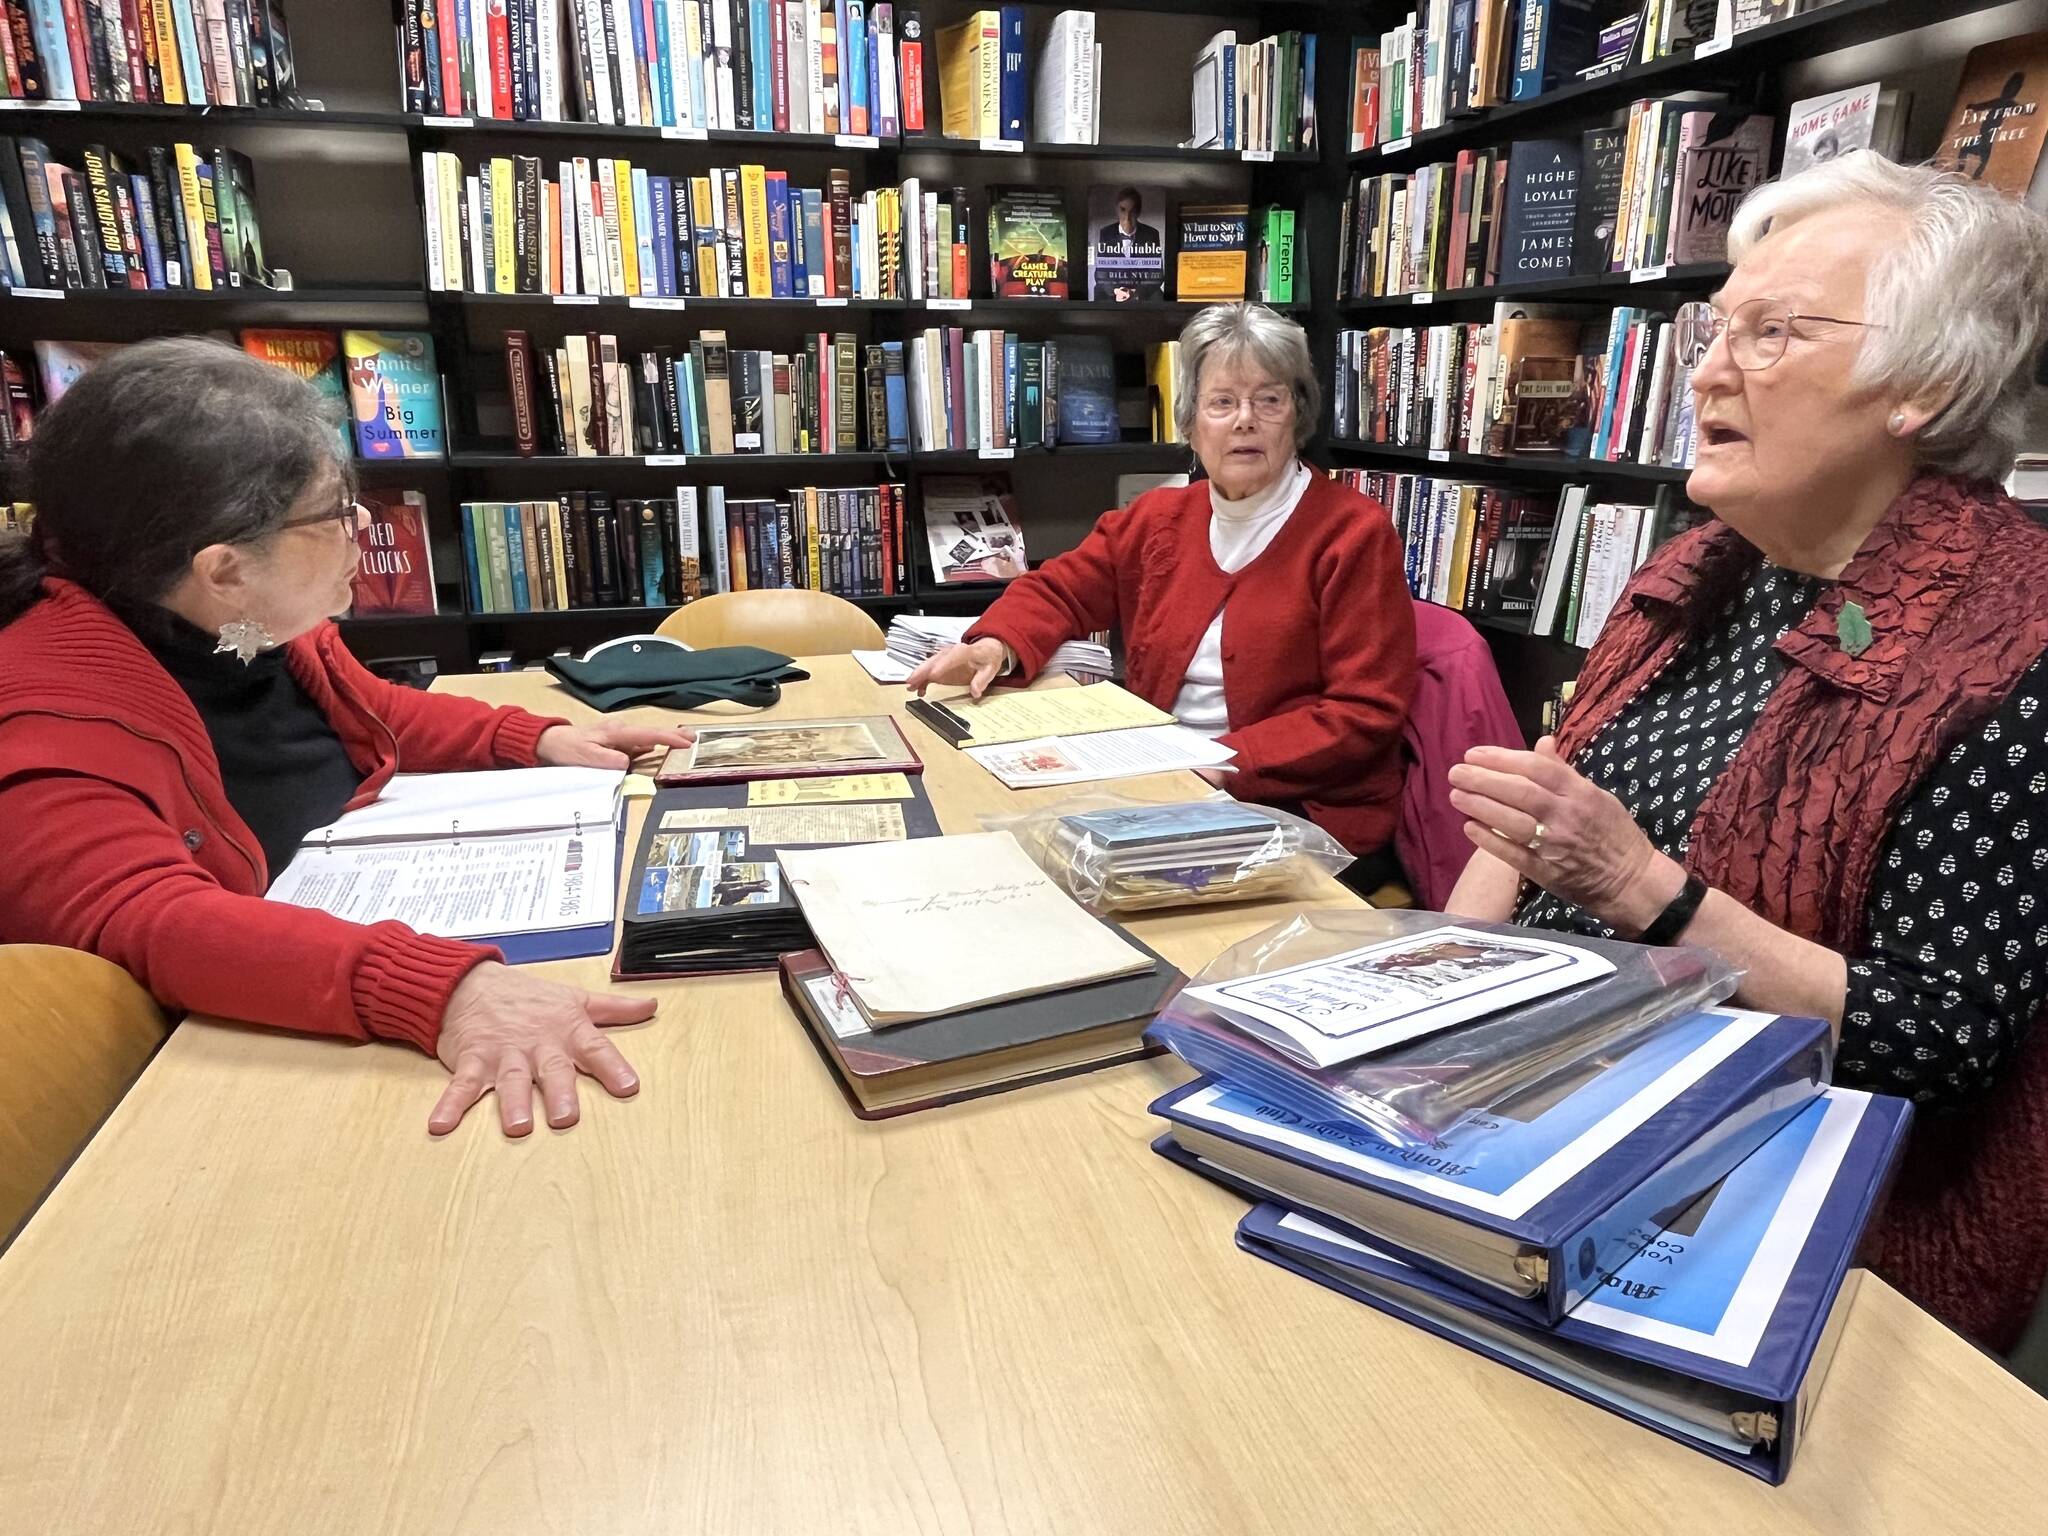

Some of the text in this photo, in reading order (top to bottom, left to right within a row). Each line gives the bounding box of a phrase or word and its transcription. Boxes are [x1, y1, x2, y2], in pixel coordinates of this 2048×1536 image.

[511, 9, 520, 49] CLINTON
[588, 0, 606, 75] GANDHI
[496, 35, 507, 93] MATRIARCH
[543, 26, 553, 101] HARRY SPARE
[813, 40, 824, 94] Educated
[983, 41, 991, 118] WORD MENU
[1520, 55, 1532, 72] LES
[1791, 93, 1872, 140] HOME GAME
[1994, 101, 2038, 121] FROM
[1553, 154, 1561, 163] A
[1697, 150, 1753, 189] LIKE
[1526, 170, 1576, 184] HIGHE
[84, 151, 121, 252] JOHN SANDFORD
[655, 190, 664, 211] DIANA
[1524, 189, 1579, 202] LOYALT
[116, 185, 136, 250] JOHN SANDFORD
[517, 180, 526, 255] Known Unknown
[526, 162, 537, 277] DONALD RUMSFELD
[582, 202, 594, 256] Educated
[602, 186, 619, 241] POLITICIAN
[657, 212, 667, 237] PALMER
[675, 189, 689, 241] DIANA PALMER
[750, 184, 762, 245] DAVID BALDACCI
[1183, 221, 1245, 233] What to Say &
[1097, 242, 1162, 254] Undeniable
[1184, 232, 1244, 244] How to Say It
[730, 239, 743, 276] THE INN
[1013, 270, 1057, 278] CREATURES
[1021, 262, 1048, 270] GAMES
[1281, 234, 1292, 282] French
[1025, 278, 1045, 286] PLAY
[266, 340, 321, 357] ROBERT
[1468, 329, 1476, 364] ONCE
[353, 357, 432, 372] Jennifer
[361, 377, 430, 395] Weiner
[665, 357, 679, 433] WILLIAM FAULKNER
[1464, 367, 1475, 401] UPON
[1521, 385, 1571, 393] THE CIVIL WAR
[385, 406, 414, 425] Big
[1460, 414, 1469, 439] CAR
[364, 425, 438, 441] Summer
[681, 490, 693, 551] MATTHEW REILLY
[1449, 489, 1460, 525] BAILOUT
[369, 522, 395, 547] RED
[780, 515, 792, 563] REVENANT
[1595, 519, 1605, 553] WINNERS
[362, 549, 412, 576] CLOCKS
[1467, 538, 1482, 608] BOB WOODWARD
[1570, 538, 1587, 598] INDEPENDENT
[559, 872, 584, 917] 1984-1985
[1304, 986, 1366, 1011] Study
[1255, 1105, 1303, 1125] Club
[1376, 1142, 1476, 1176] Monday
